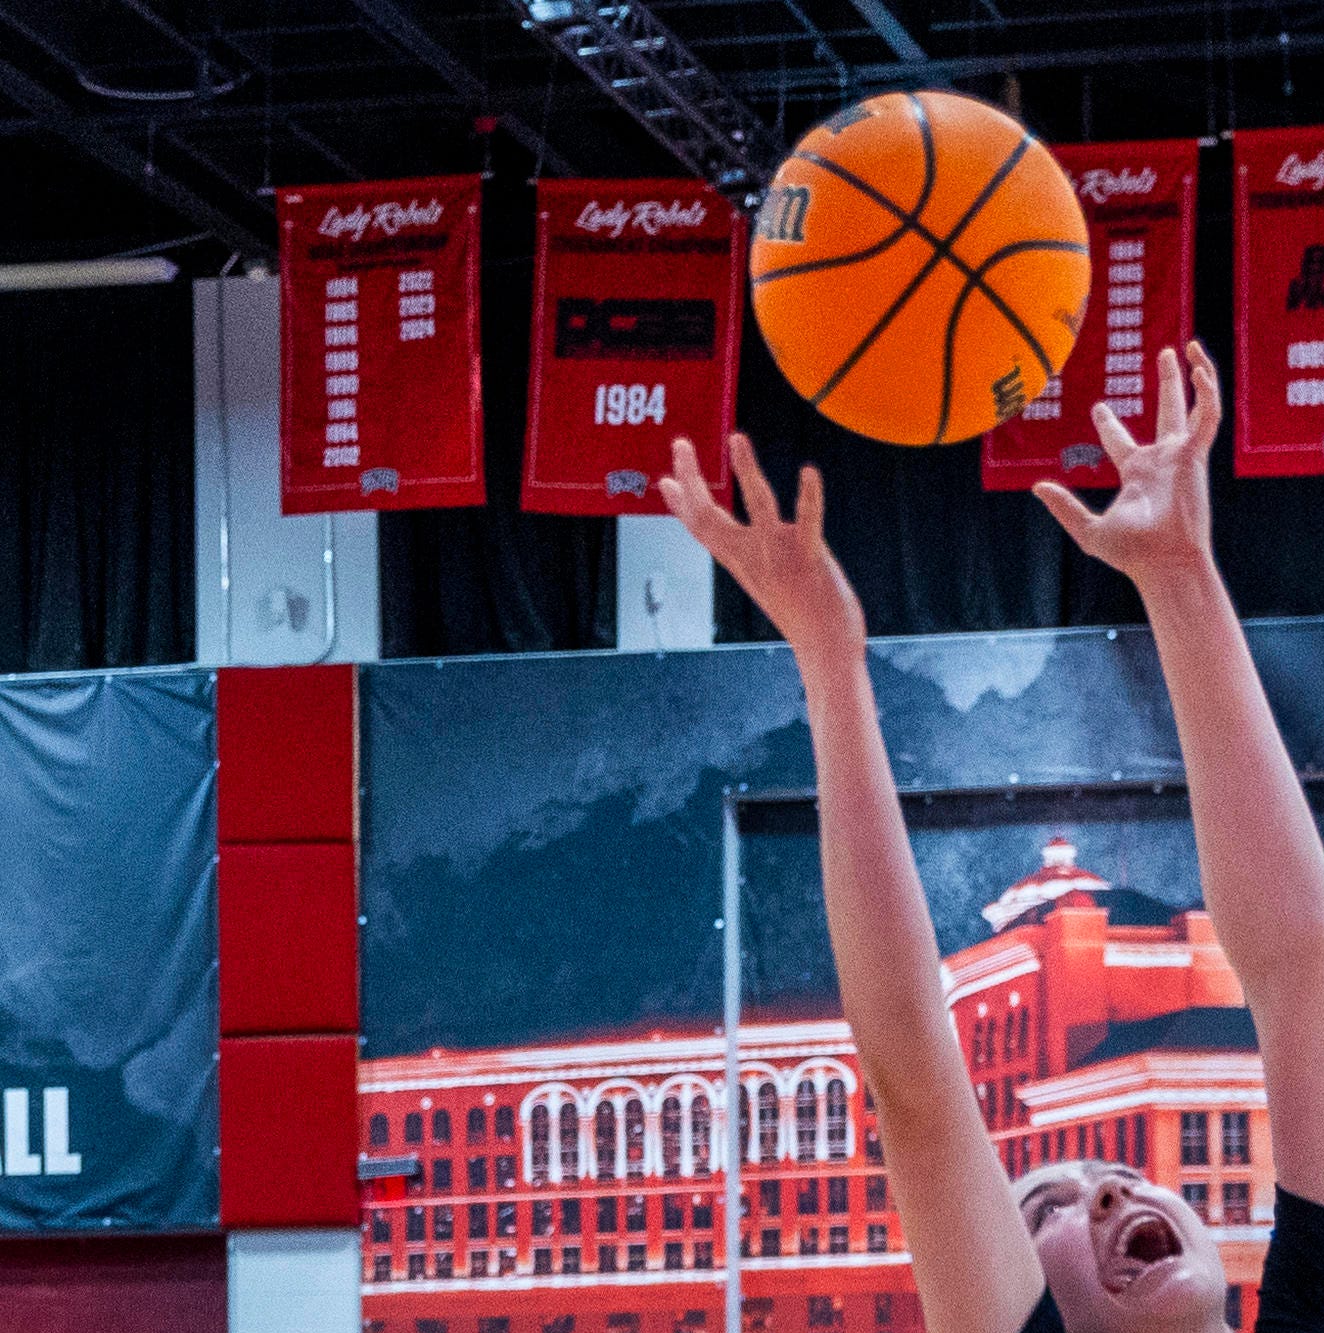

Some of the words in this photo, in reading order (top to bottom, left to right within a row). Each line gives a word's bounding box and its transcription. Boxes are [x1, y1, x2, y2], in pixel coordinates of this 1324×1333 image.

[318, 204, 372, 242] Lady
[372, 198, 445, 236] Rebels
[575, 201, 631, 238] Lady
[631, 198, 708, 236] Rebels
[594, 383, 667, 427] 1984
